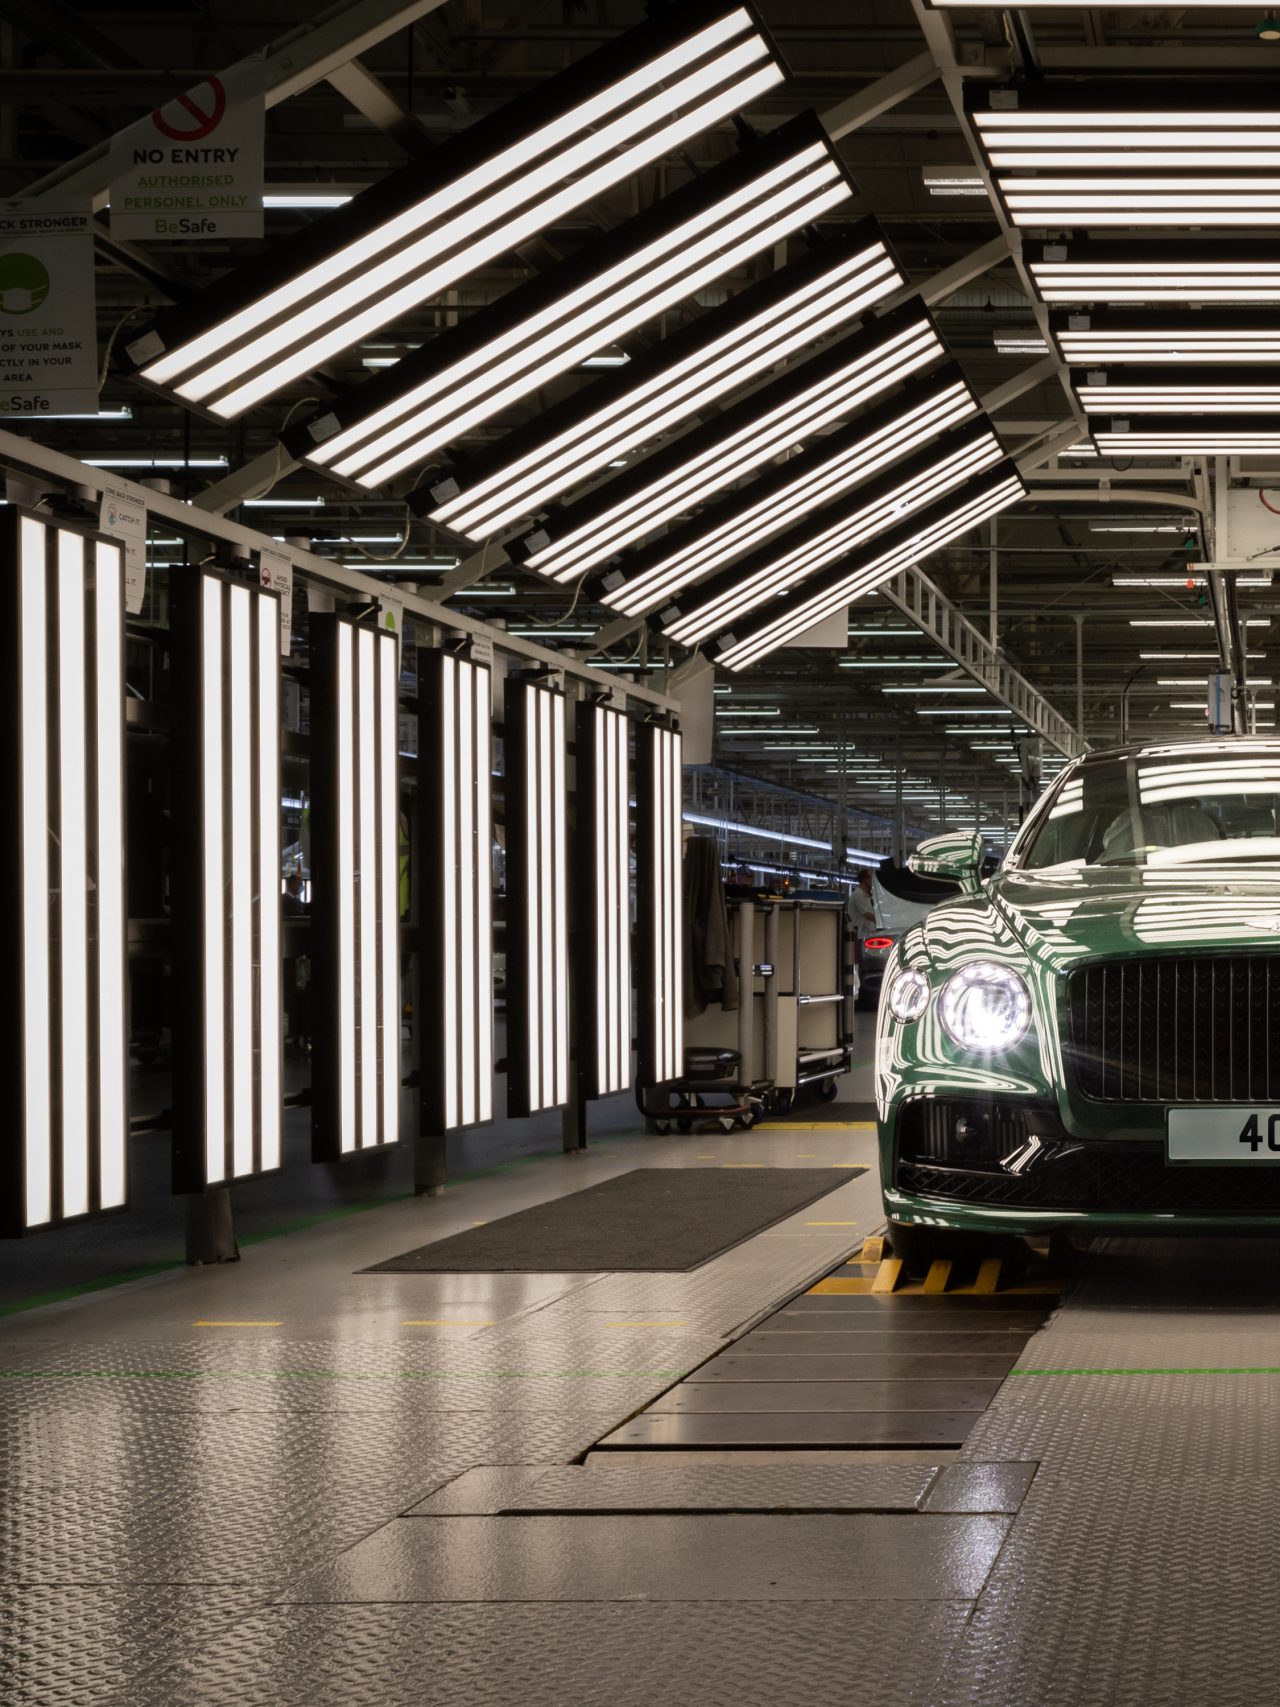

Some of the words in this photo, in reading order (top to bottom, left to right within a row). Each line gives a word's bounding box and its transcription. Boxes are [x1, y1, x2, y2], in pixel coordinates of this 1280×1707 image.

[133, 149, 164, 163] NO
[171, 148, 239, 163] ENTRY
[138, 175, 234, 186] AUTHORISED
[124, 197, 205, 208] PERSONEL
[208, 195, 248, 207] ONLY
[19, 217, 88, 229] STRONGER
[155, 218, 216, 234] BeSafe
[41, 328, 64, 336] AND
[1, 344, 16, 352] OF
[20, 343, 49, 351] YOUR
[53, 342, 82, 350] MASK
[43, 357, 72, 366] YOUR
[3, 374, 33, 382] AREA
[119, 513, 134, 523] CATCH
